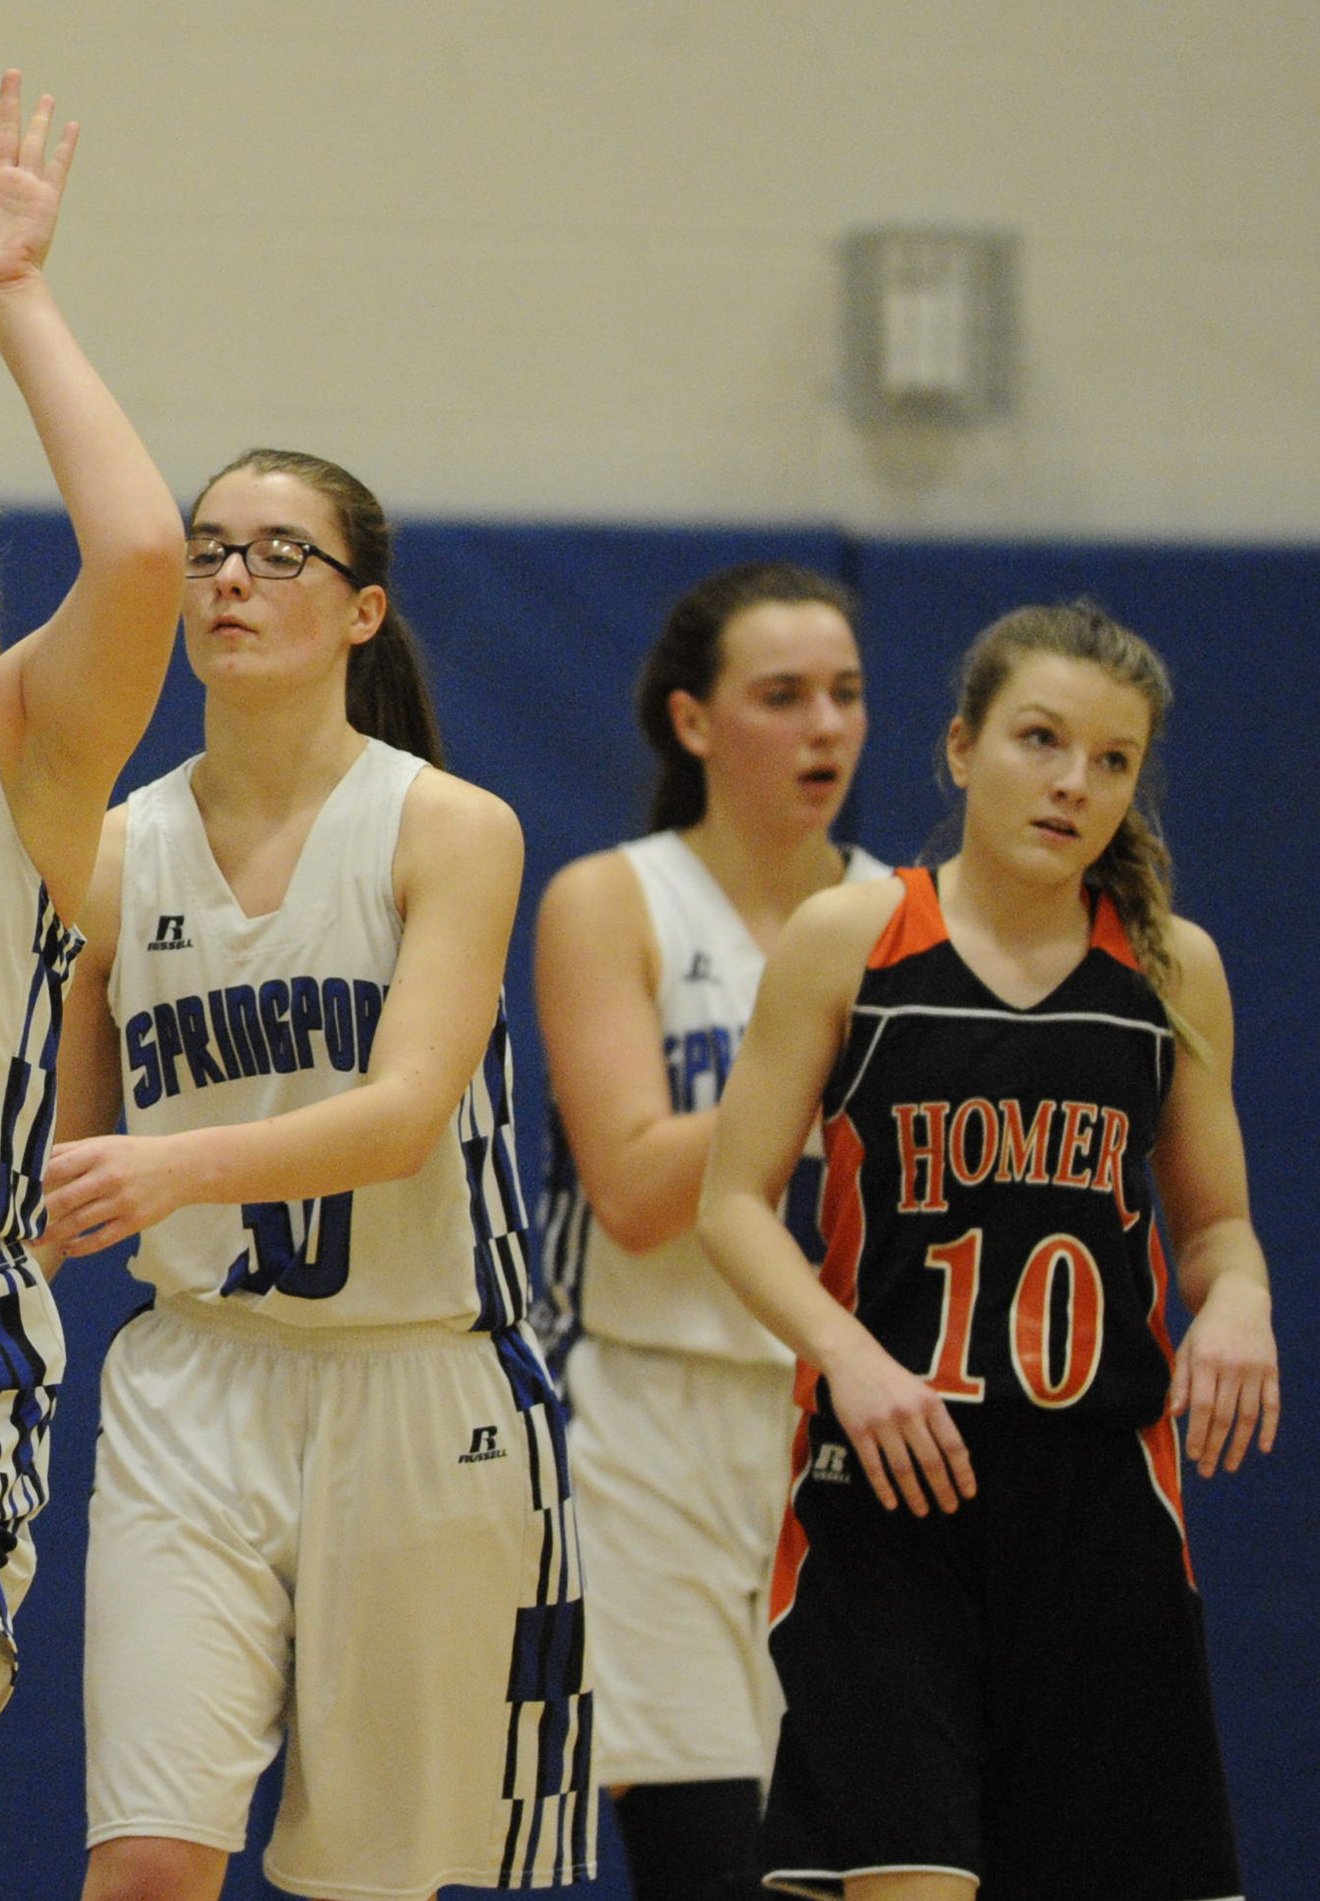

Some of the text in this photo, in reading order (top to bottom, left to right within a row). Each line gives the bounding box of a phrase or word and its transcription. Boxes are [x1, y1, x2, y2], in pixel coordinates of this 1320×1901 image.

[126, 976, 390, 1109] SPRINGPOR
[892, 1098, 1139, 1231] HOMER
[924, 1227, 1104, 1409] 10
